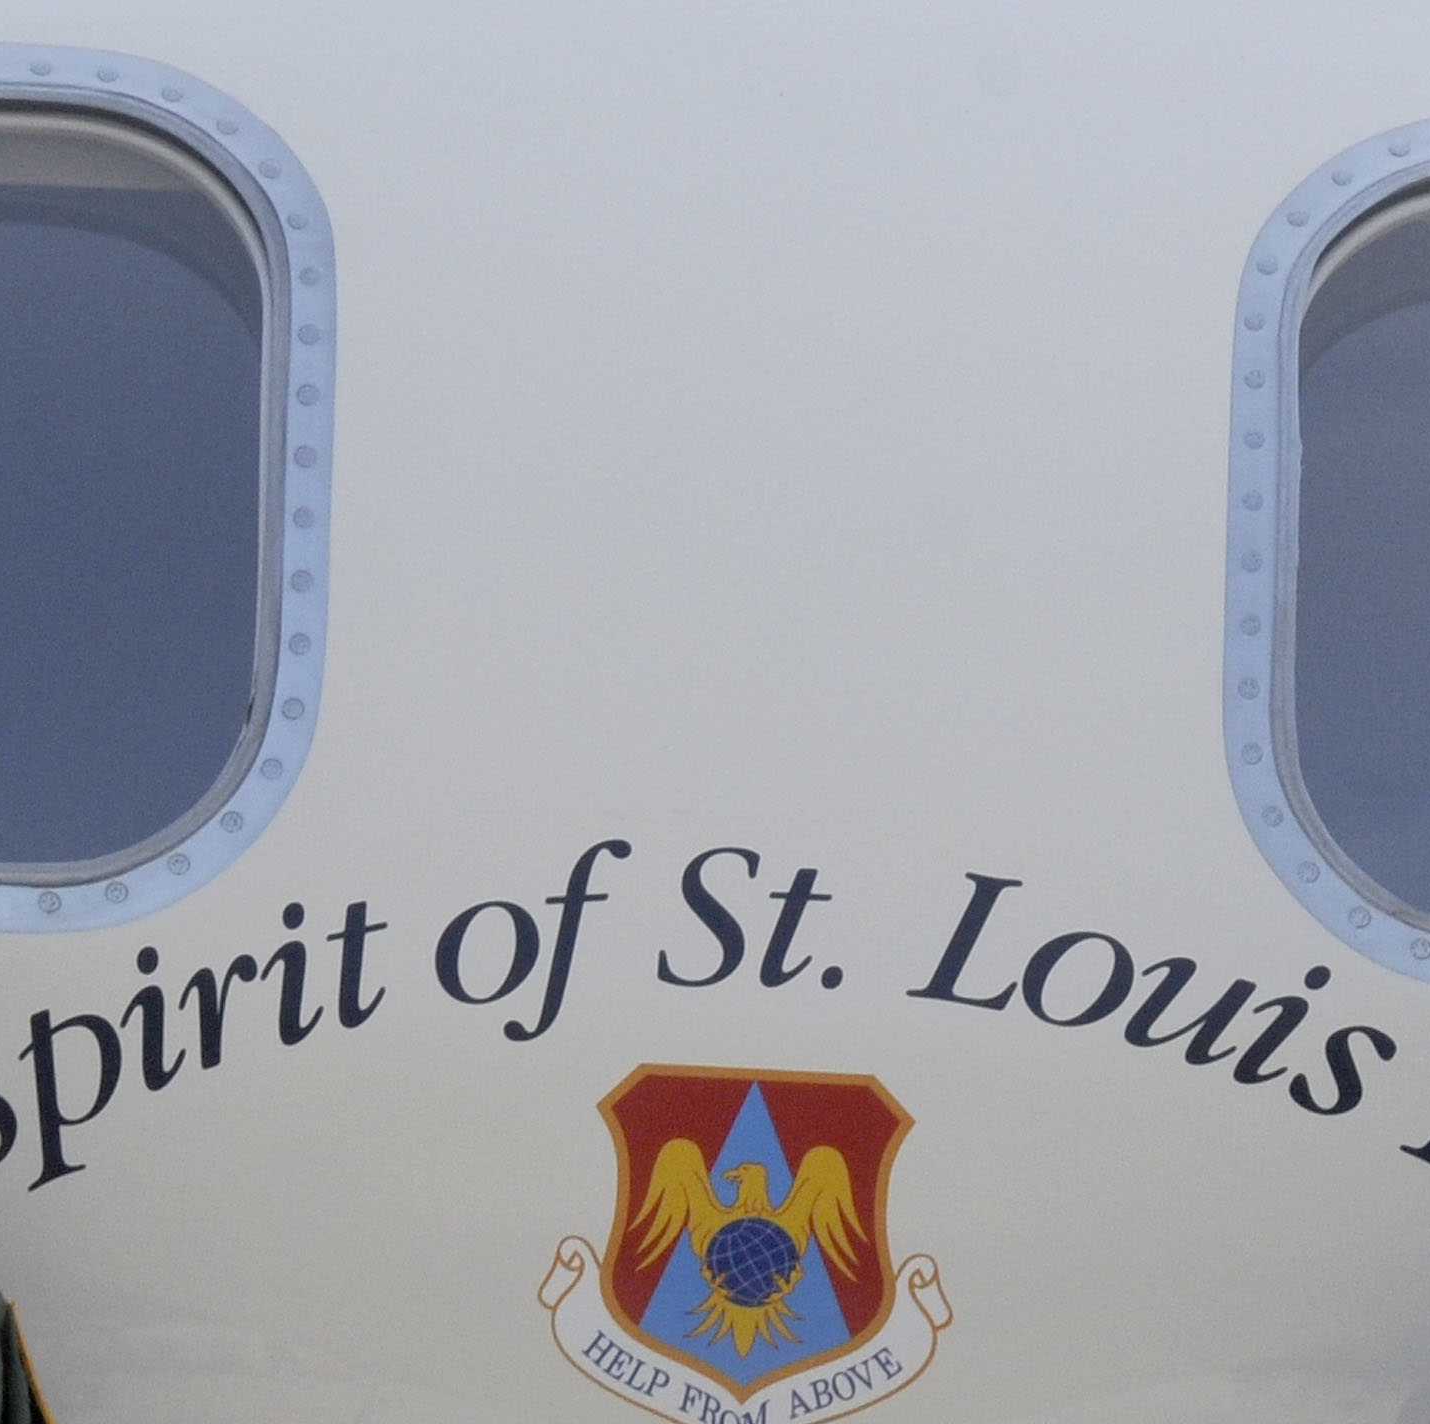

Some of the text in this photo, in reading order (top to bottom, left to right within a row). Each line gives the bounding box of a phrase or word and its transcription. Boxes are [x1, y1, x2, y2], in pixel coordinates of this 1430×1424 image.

[434, 839, 632, 1042] of
[656, 845, 844, 991] St.
[905, 872, 1397, 1117] Louis
[582, 1330, 670, 1398] HELP
[788, 1347, 903, 1419] ABOVE
